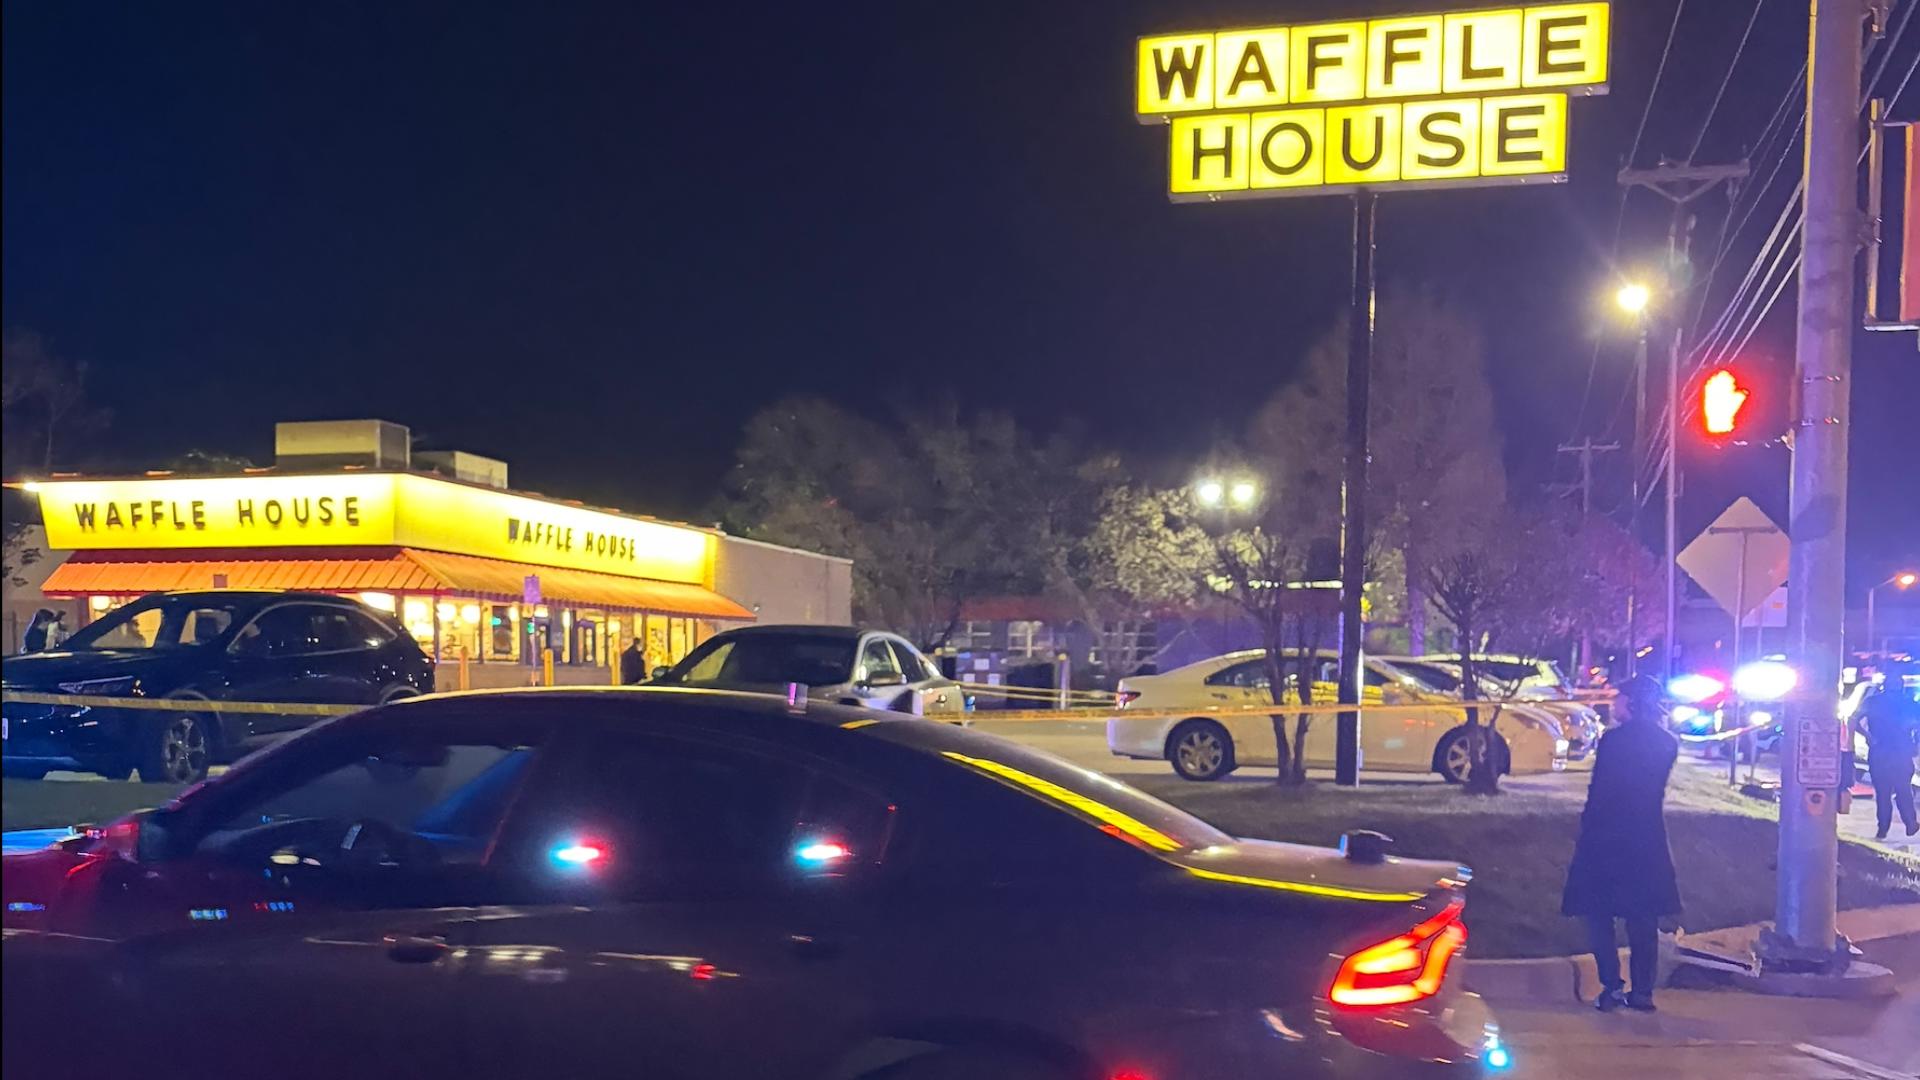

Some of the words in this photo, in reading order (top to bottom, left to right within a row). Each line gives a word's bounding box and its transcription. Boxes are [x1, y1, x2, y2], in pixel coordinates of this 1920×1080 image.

[1152, 15, 1587, 100] WAFFLE
[1192, 106, 1545, 180] HOUSE
[75, 501, 205, 530] WAFFLE
[238, 496, 360, 526] HOUSE
[508, 517, 572, 552] WAFFLE
[585, 531, 636, 561] HOUSE
